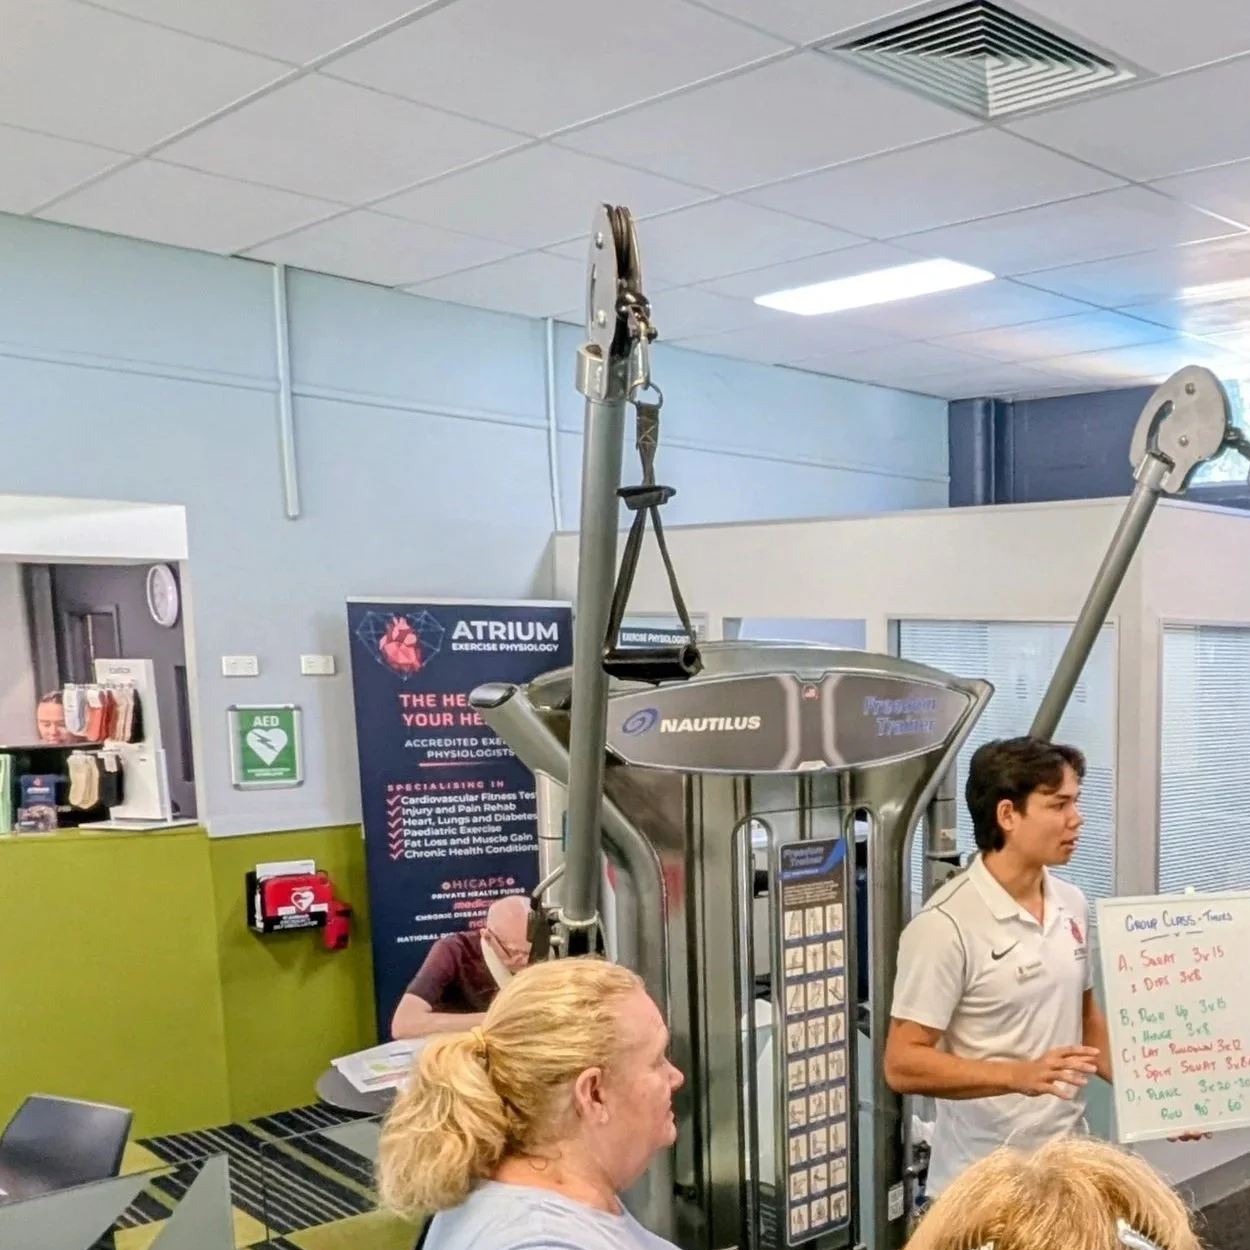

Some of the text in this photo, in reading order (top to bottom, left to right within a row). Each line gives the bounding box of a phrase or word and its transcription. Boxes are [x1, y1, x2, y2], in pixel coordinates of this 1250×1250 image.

[451, 620, 559, 641] ATRIUM
[451, 642, 559, 652] EXERCISE PHYSIOLOGY
[399, 694, 471, 708] THE HE
[253, 715, 280, 727] AED
[402, 712, 488, 727] YOUR HE
[660, 716, 761, 733] NAUTILUS
[404, 738, 478, 748] ACCREDITED
[427, 749, 515, 758] PHYSIOLOGISTS
[387, 780, 504, 792] SPECIALISING IN
[400, 790, 536, 805] Cardiovascular Fitness Tes
[402, 801, 517, 817] Injury and Pain Rehab
[438, 815, 470, 825] Lungs
[472, 813, 493, 823] and
[494, 811, 538, 822] Diabetes
[403, 824, 502, 838] Paediatric Exercise
[404, 832, 533, 848] Fat Loss and Muscle Gain
[404, 843, 538, 859] Chronic Health Conditions
[452, 877, 505, 889] HICAPS
[431, 892, 466, 900] PRIVATE
[467, 889, 499, 898] HEALTH
[1162, 910, 1196, 927] CLASS
[397, 934, 438, 943] NATIONAL
